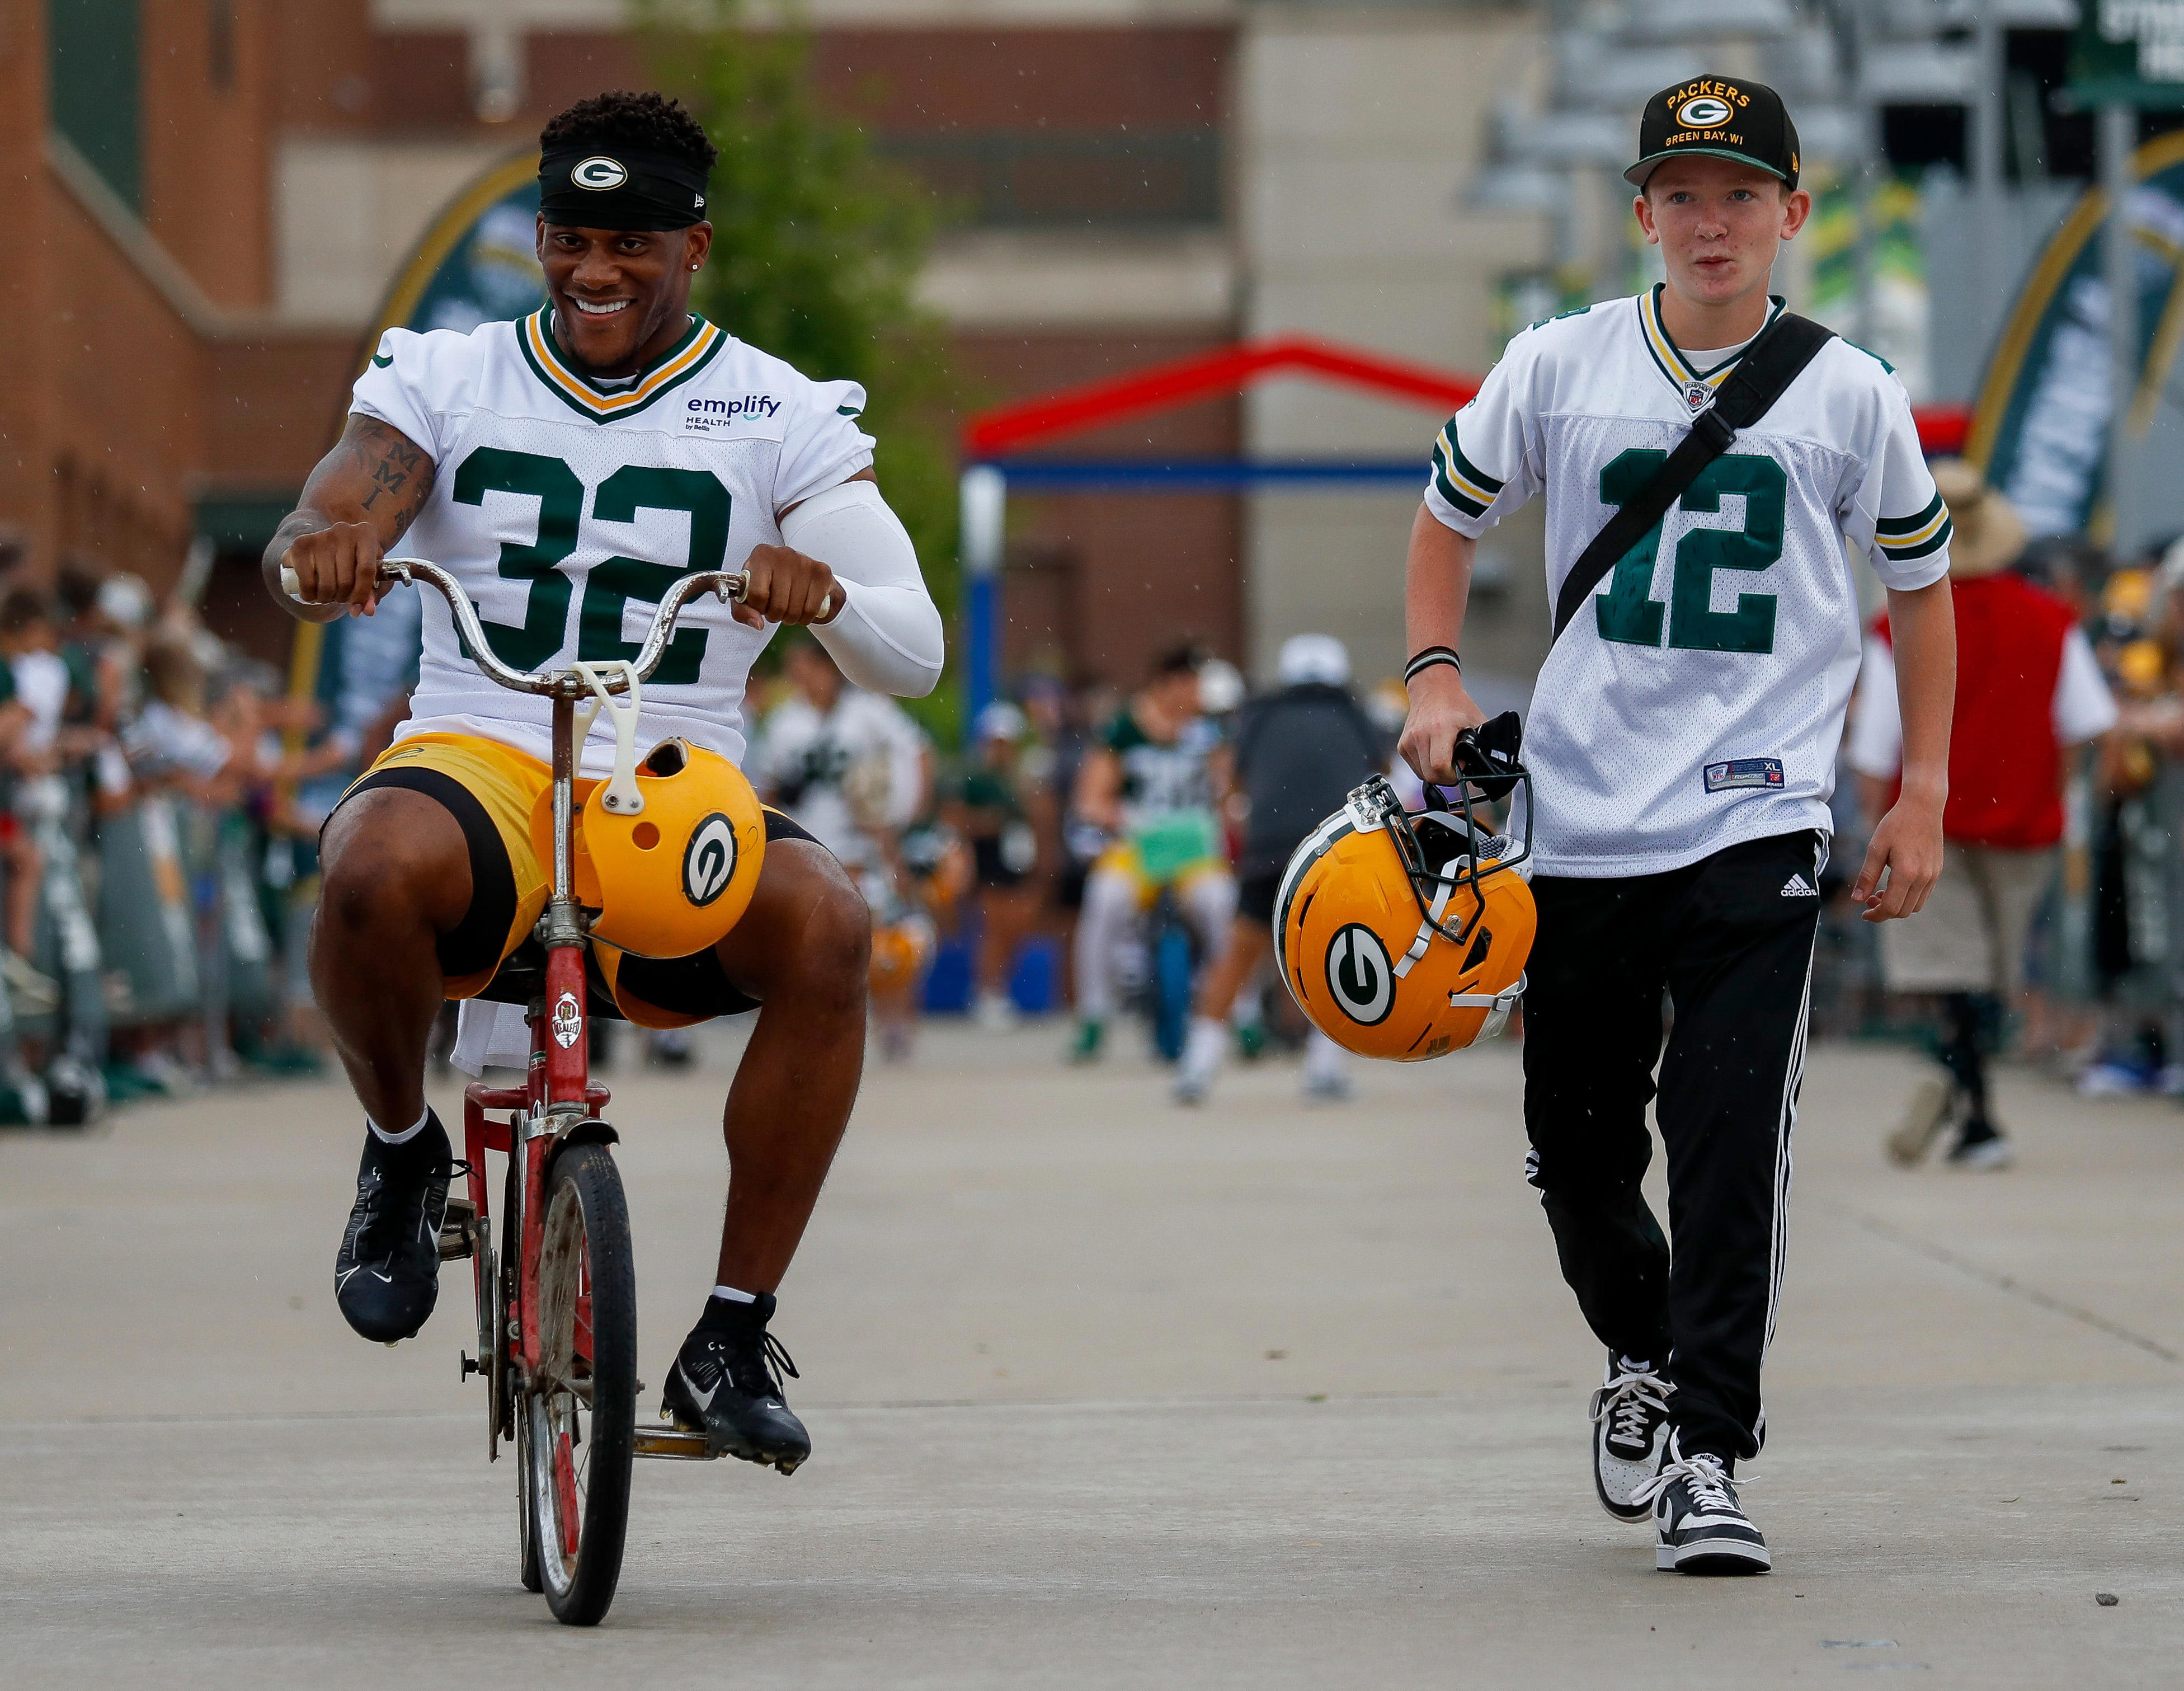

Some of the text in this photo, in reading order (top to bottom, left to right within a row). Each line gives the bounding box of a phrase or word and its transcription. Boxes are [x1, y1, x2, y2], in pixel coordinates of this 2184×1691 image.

[1667, 80, 1750, 110] PACKERS
[1679, 97, 1730, 126] G
[1665, 130, 1744, 147] GREEN BAY, WI
[573, 158, 626, 189] G
[686, 416, 731, 427] HEALTH
[688, 395, 782, 419] emplify
[453, 445, 732, 684] 32
[1595, 448, 1787, 654] 12
[1764, 762, 1781, 772] XL
[686, 817, 735, 903] G
[1780, 887, 1818, 897] adidas
[1328, 926, 1393, 1023] G
